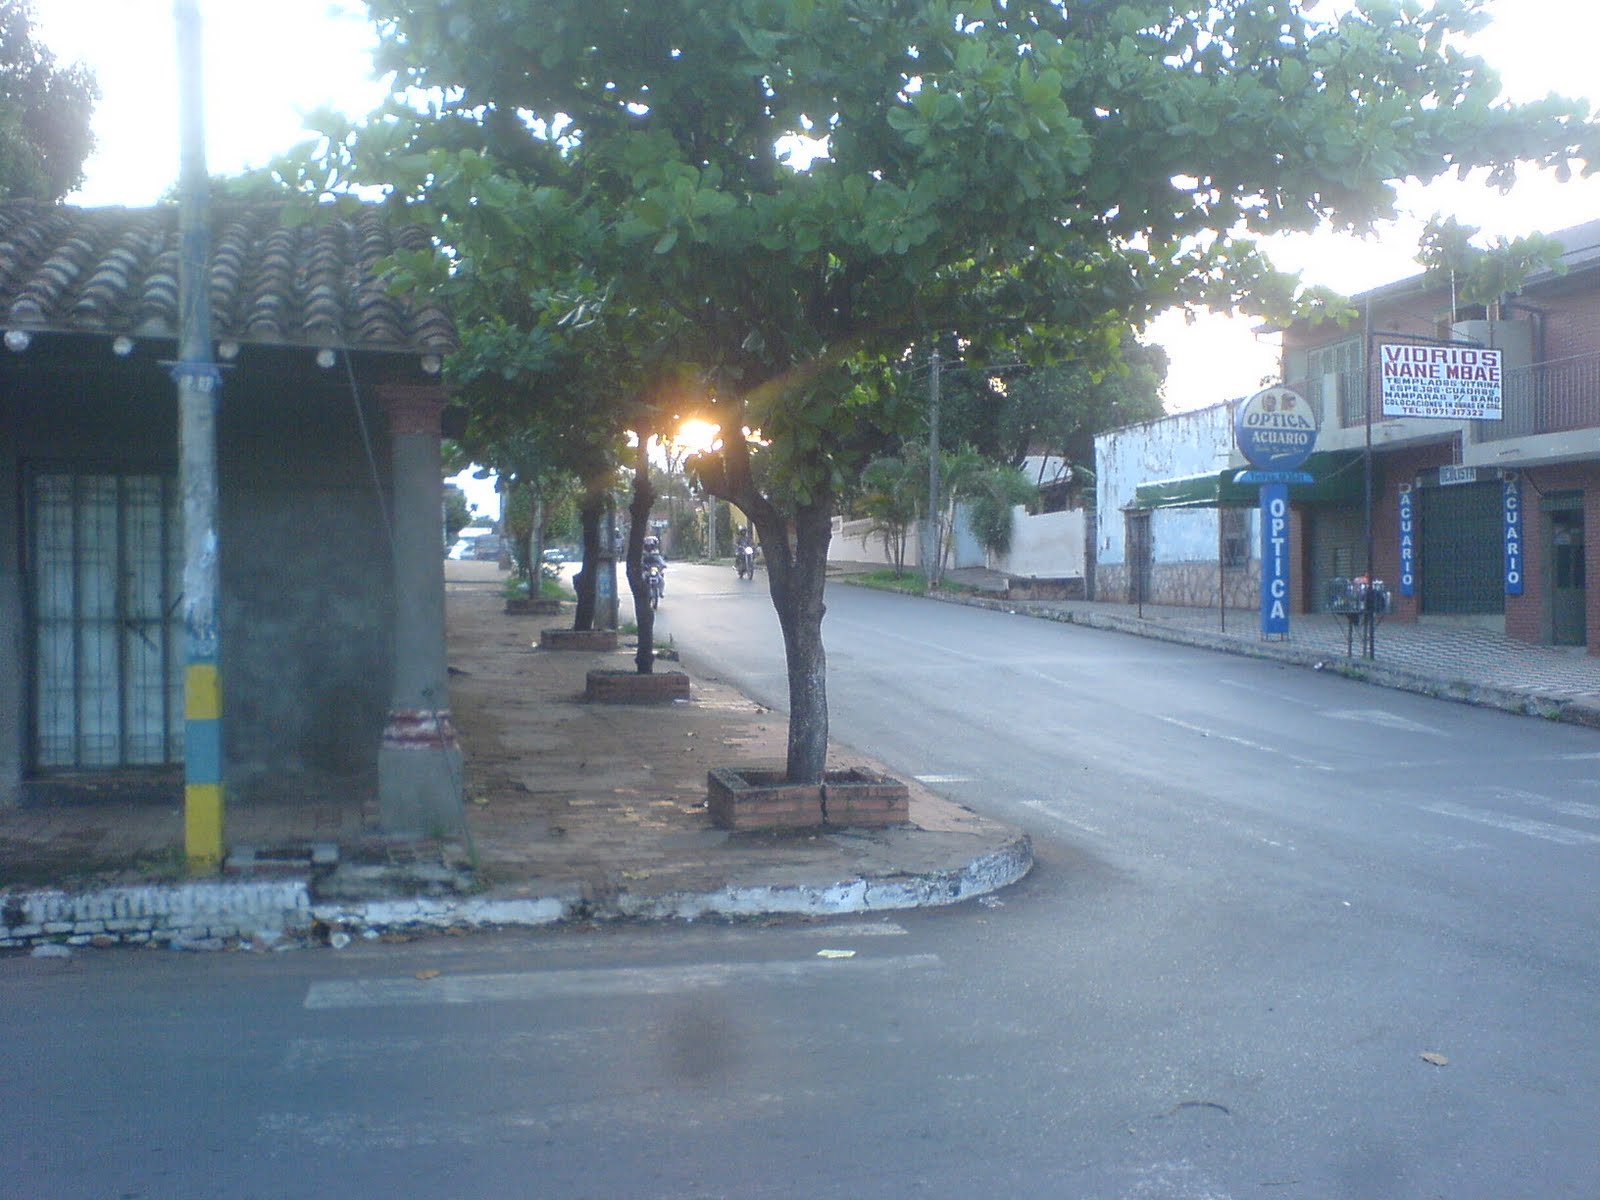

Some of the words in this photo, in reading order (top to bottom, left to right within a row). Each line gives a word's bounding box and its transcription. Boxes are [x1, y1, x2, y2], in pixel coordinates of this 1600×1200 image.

[1385, 347, 1497, 366] VIDRIOS
[1384, 392, 1446, 400] MAMPARAS
[1247, 412, 1311, 429] OPTICA
[1252, 431, 1308, 445] ACUARIO
[1401, 495, 1412, 585] ACUARIO
[1506, 484, 1519, 584] ACUARIO
[1270, 498, 1285, 619] OPTICA
